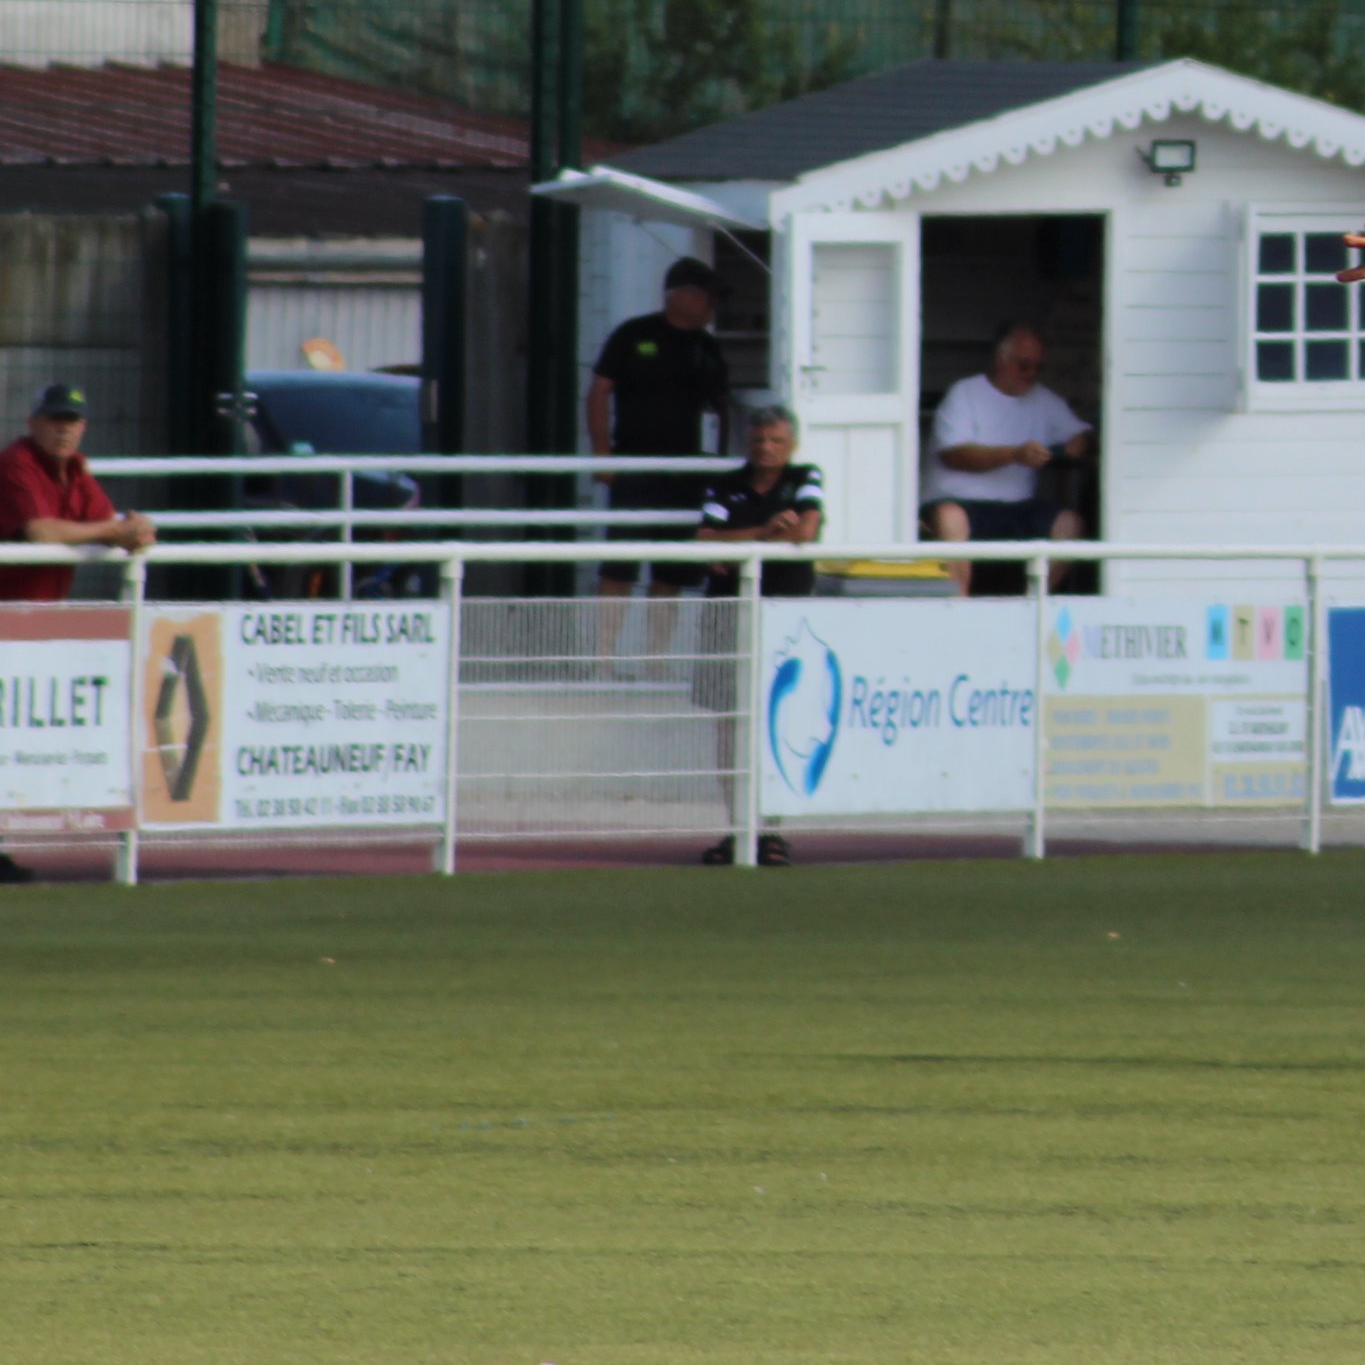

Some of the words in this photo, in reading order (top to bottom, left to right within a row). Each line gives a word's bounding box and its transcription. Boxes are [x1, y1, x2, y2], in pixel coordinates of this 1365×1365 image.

[241, 612, 307, 645] CABEL
[312, 612, 337, 645] ET
[339, 612, 381, 645] FILS
[385, 611, 437, 644] SARL
[0, 675, 110, 728] ILLET
[850, 675, 941, 747] Région
[950, 672, 1035, 728] Centre
